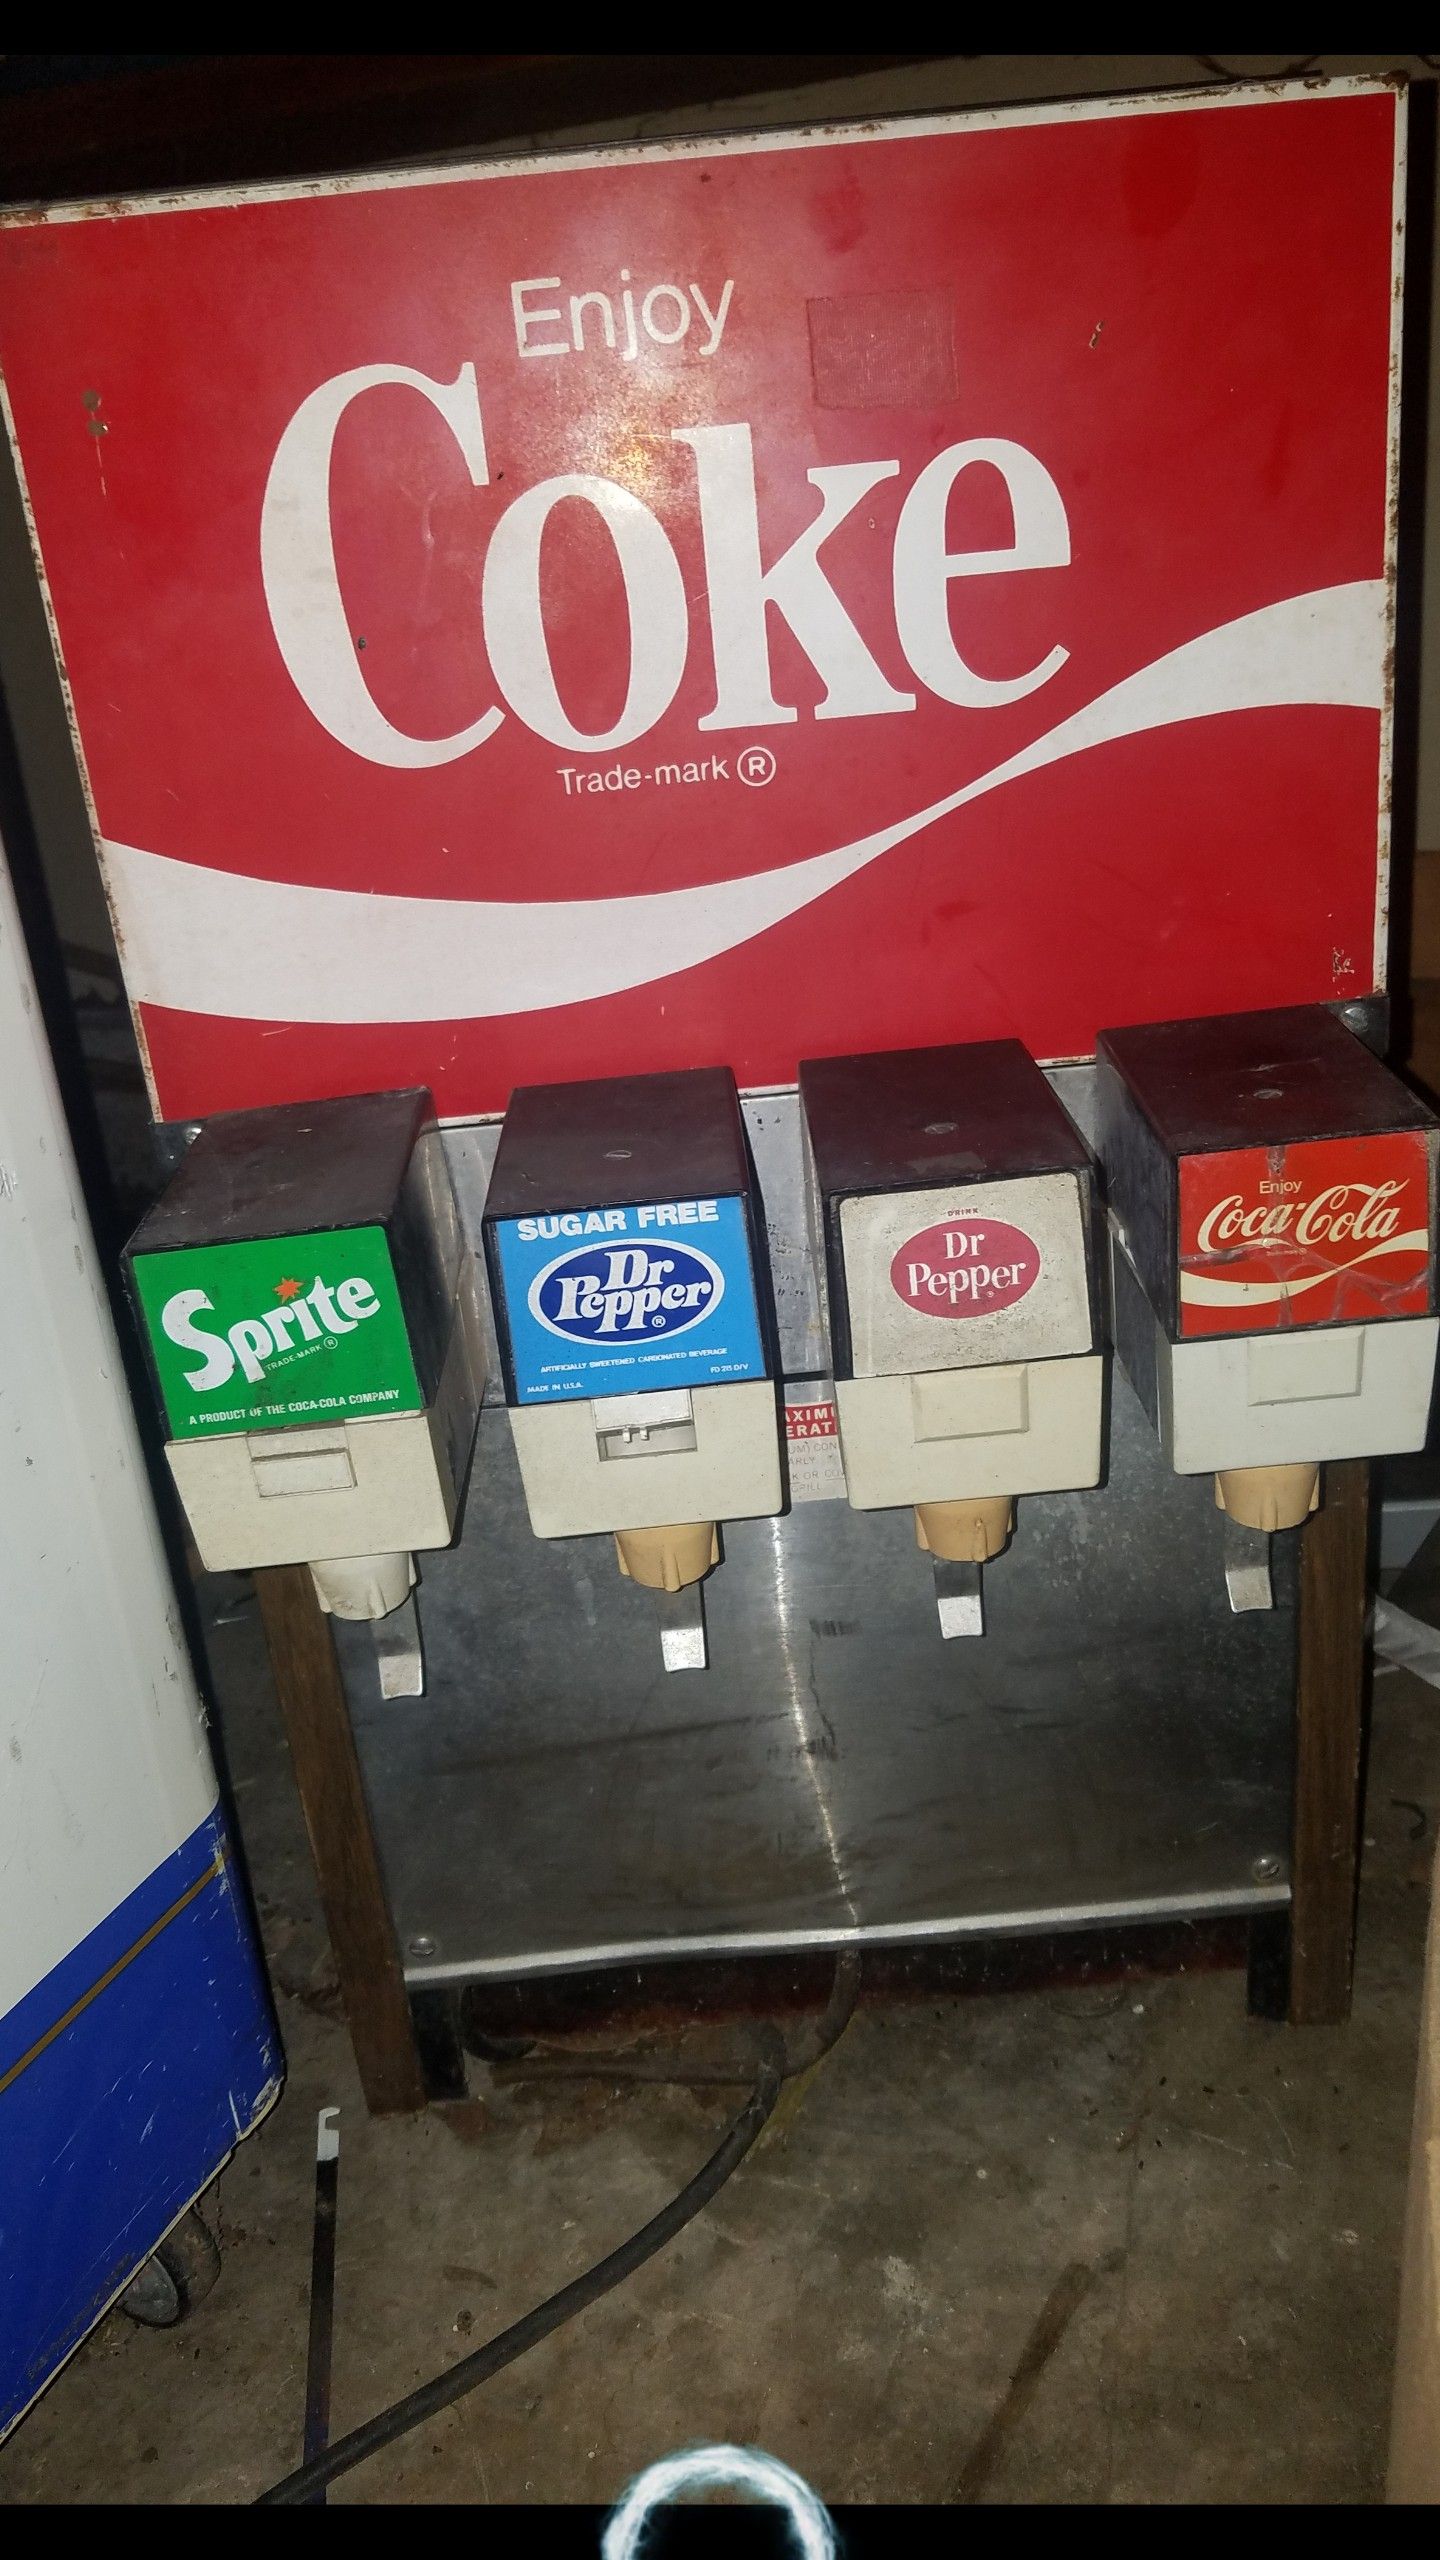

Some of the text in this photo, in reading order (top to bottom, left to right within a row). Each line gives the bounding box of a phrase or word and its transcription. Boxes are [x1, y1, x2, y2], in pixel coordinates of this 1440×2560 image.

[511, 270, 734, 362] Enjoy
[260, 361, 1071, 769] Coke
[555, 754, 730, 795] Trade-mark
[1259, 1179, 1302, 1194] Enjoy
[516, 1200, 720, 1241] SUGAR FREE
[947, 1207, 979, 1217] DRINK
[1197, 1178, 1410, 1252] Coca-Cola
[942, 1231, 986, 1259] Dr
[600, 1249, 675, 1291] Dr
[906, 1262, 1027, 1305] Pepper
[552, 1275, 711, 1334] Pepper
[161, 1275, 381, 1392] Sprite
[265, 1344, 322, 1371] TRADE-MARK
[540, 1362, 587, 1374] ARTIFICIALLY
[589, 1358, 635, 1368] SWEETENED
[189, 1389, 400, 1425] A PRODUCT OF THE COCA-COLA COMPANY
[526, 1385, 549, 1393] MADE
